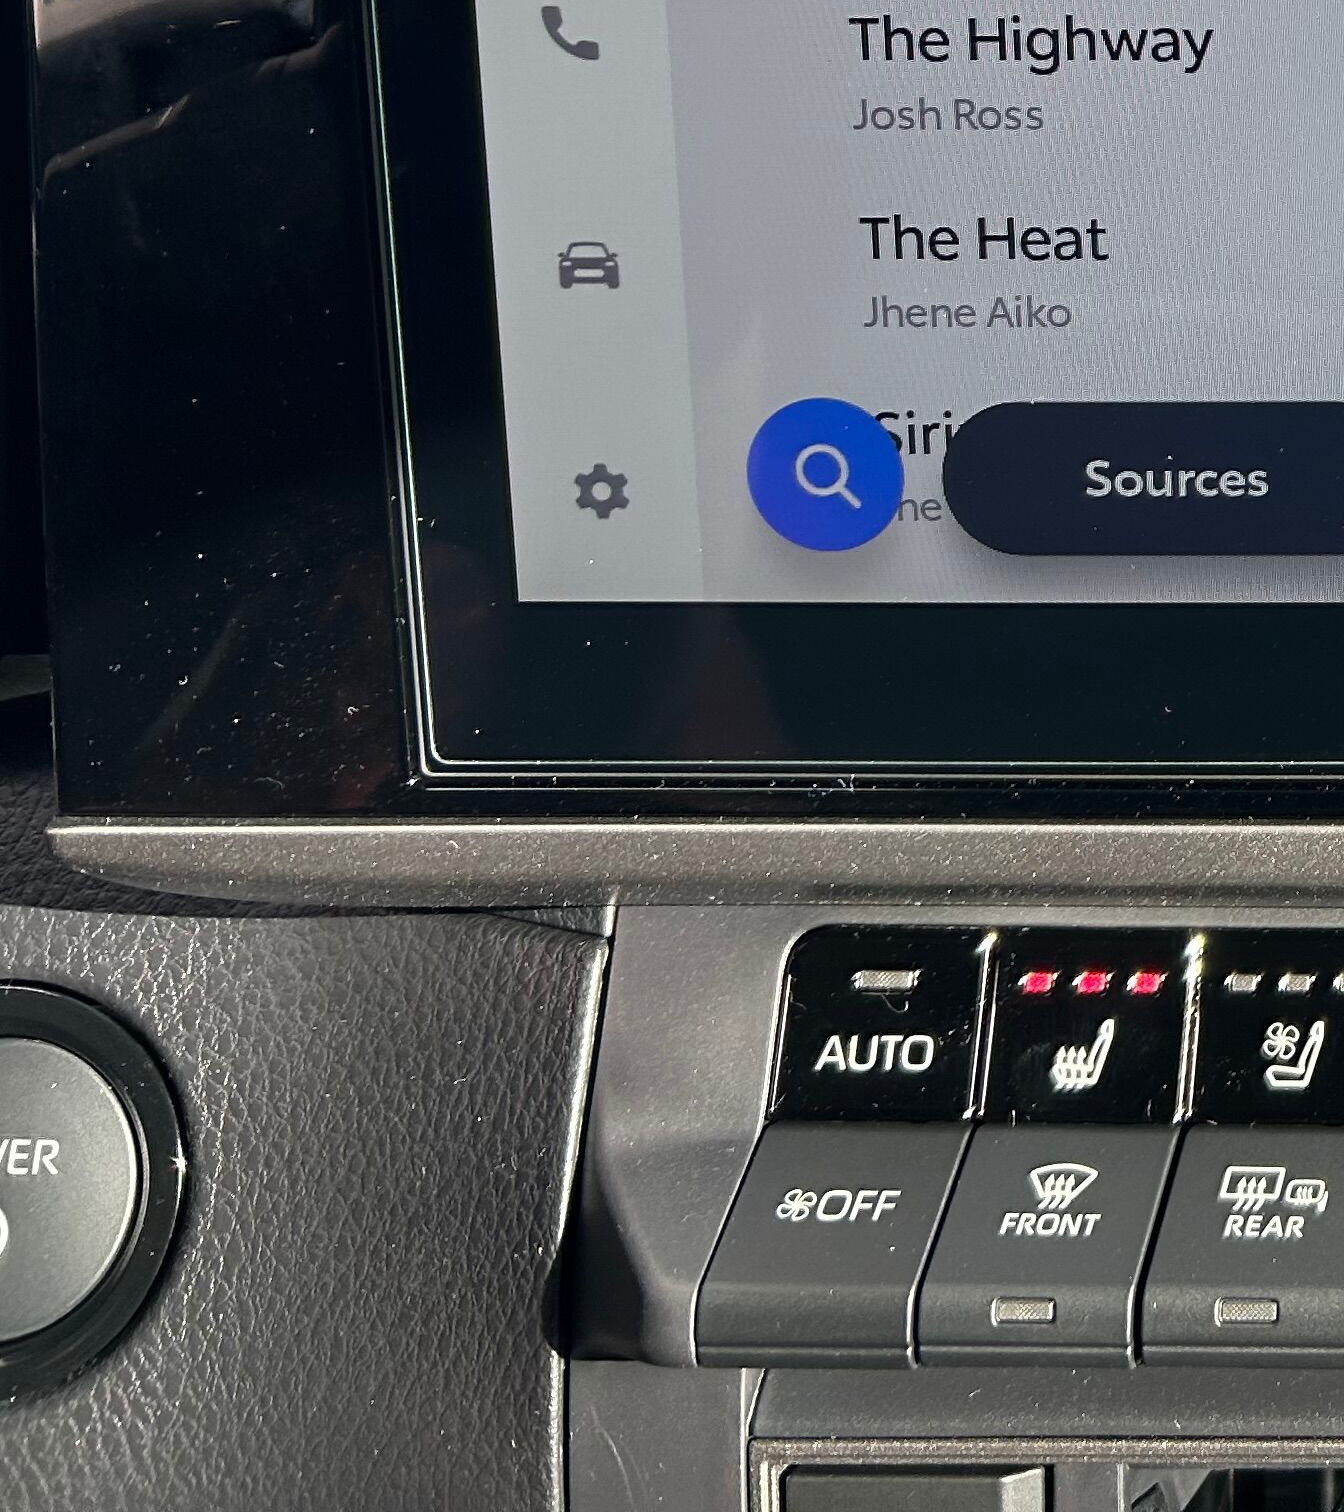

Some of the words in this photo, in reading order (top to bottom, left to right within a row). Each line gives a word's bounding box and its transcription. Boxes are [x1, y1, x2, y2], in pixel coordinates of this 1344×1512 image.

[849, 15, 949, 62] The
[968, 15, 1213, 75] Highway
[853, 97, 941, 130] Josh
[954, 99, 1043, 130] Ross
[859, 215, 959, 261] The
[978, 218, 1109, 261] Heat
[864, 296, 976, 327] Jhene
[987, 295, 1071, 327] Aiko
[1086, 460, 1268, 497] Sources
[815, 1035, 934, 1071] AUTO
[817, 1189, 901, 1221] OFF
[999, 1213, 1101, 1236] FRONT
[1223, 1215, 1305, 1237] REAR
